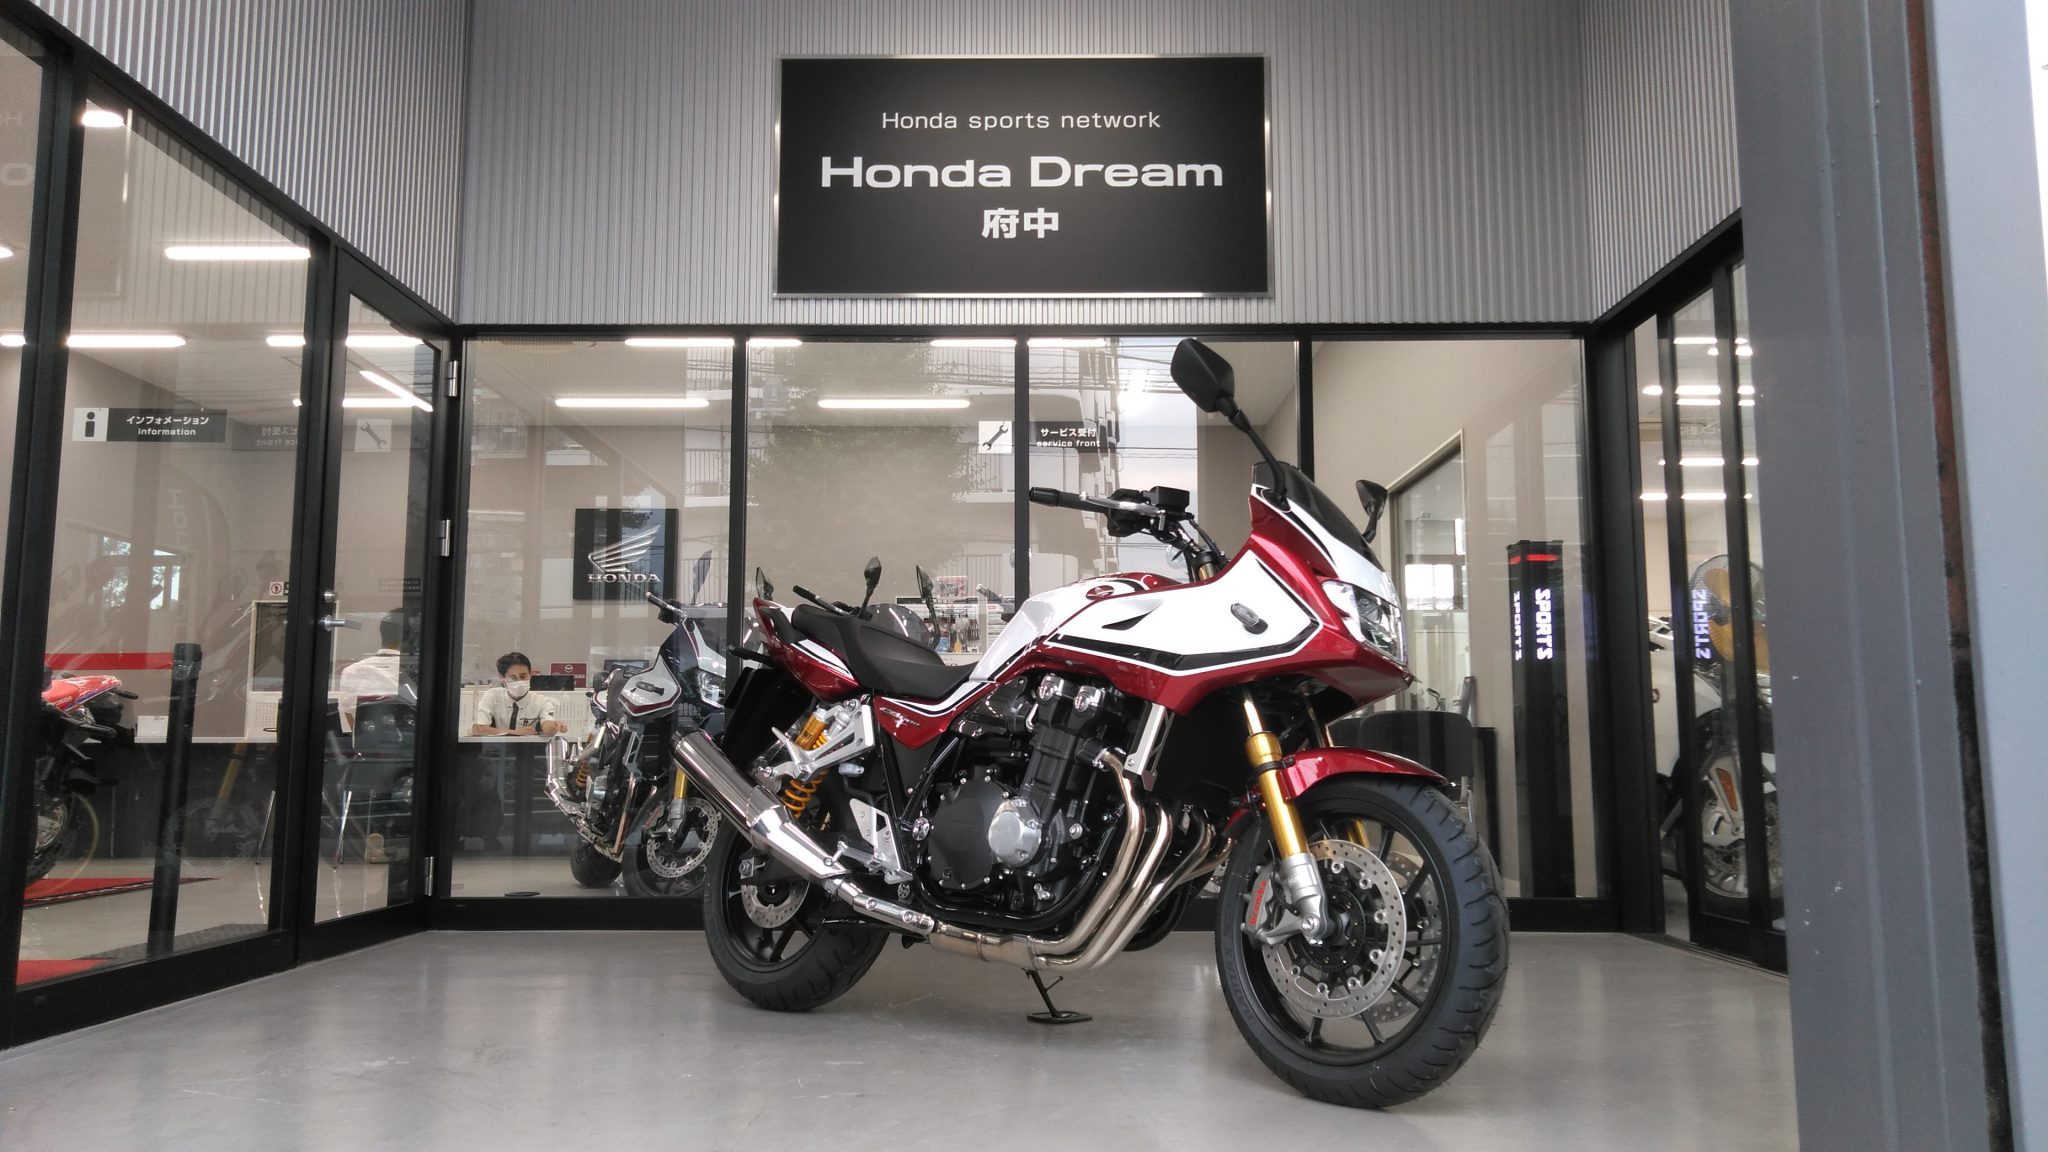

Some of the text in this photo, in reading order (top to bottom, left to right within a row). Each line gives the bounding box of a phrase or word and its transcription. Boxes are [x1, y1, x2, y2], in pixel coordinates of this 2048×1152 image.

[882, 111, 1161, 131] Honda sports network
[821, 156, 1223, 188] Honda Dream
[981, 207, 1060, 239] 府中
[126, 416, 209, 425] インフォメーション
[137, 427, 196, 436] information
[1040, 428, 1097, 437] サービス受付
[1076, 439, 1100, 447] front
[588, 573, 662, 583] HONDA
[1534, 588, 1553, 660] SPORTS
